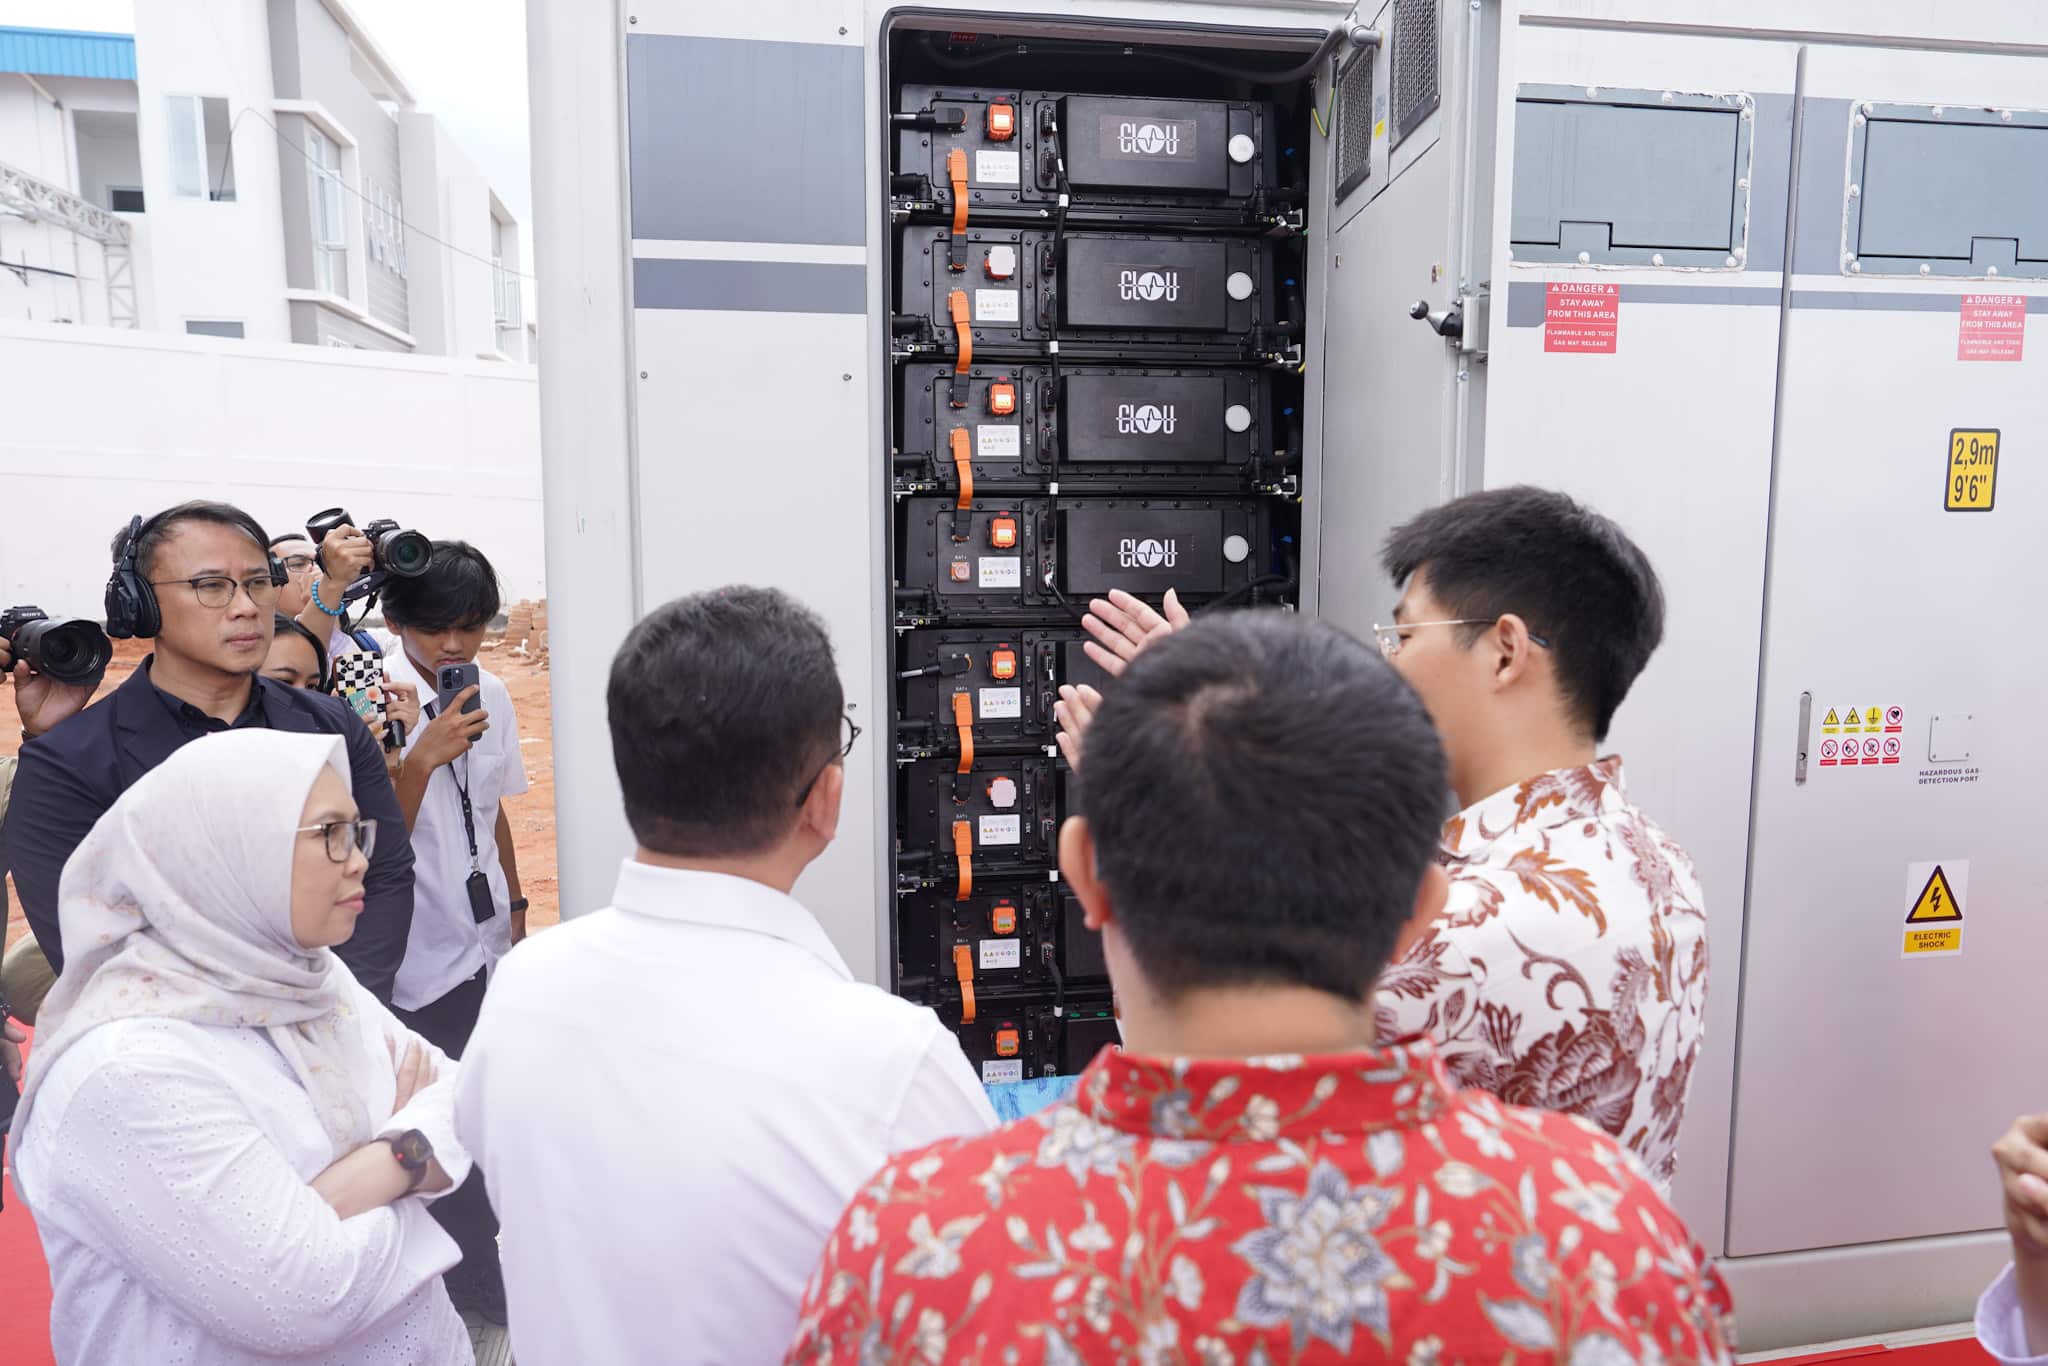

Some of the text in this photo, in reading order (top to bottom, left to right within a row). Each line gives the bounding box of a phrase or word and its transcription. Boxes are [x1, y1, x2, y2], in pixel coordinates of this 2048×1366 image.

[1561, 283, 1604, 293] DANGER
[1560, 298, 1605, 307] STAY AWAY
[1975, 295, 2013, 304] DANGER
[1547, 309, 1616, 319] FROM THIS AREA
[1954, 438, 1994, 470] 2,9m
[1954, 474, 1987, 503] 9'6"
[1913, 932, 1951, 940] ELECTRIC
[1918, 941, 1944, 949] SHOCK
